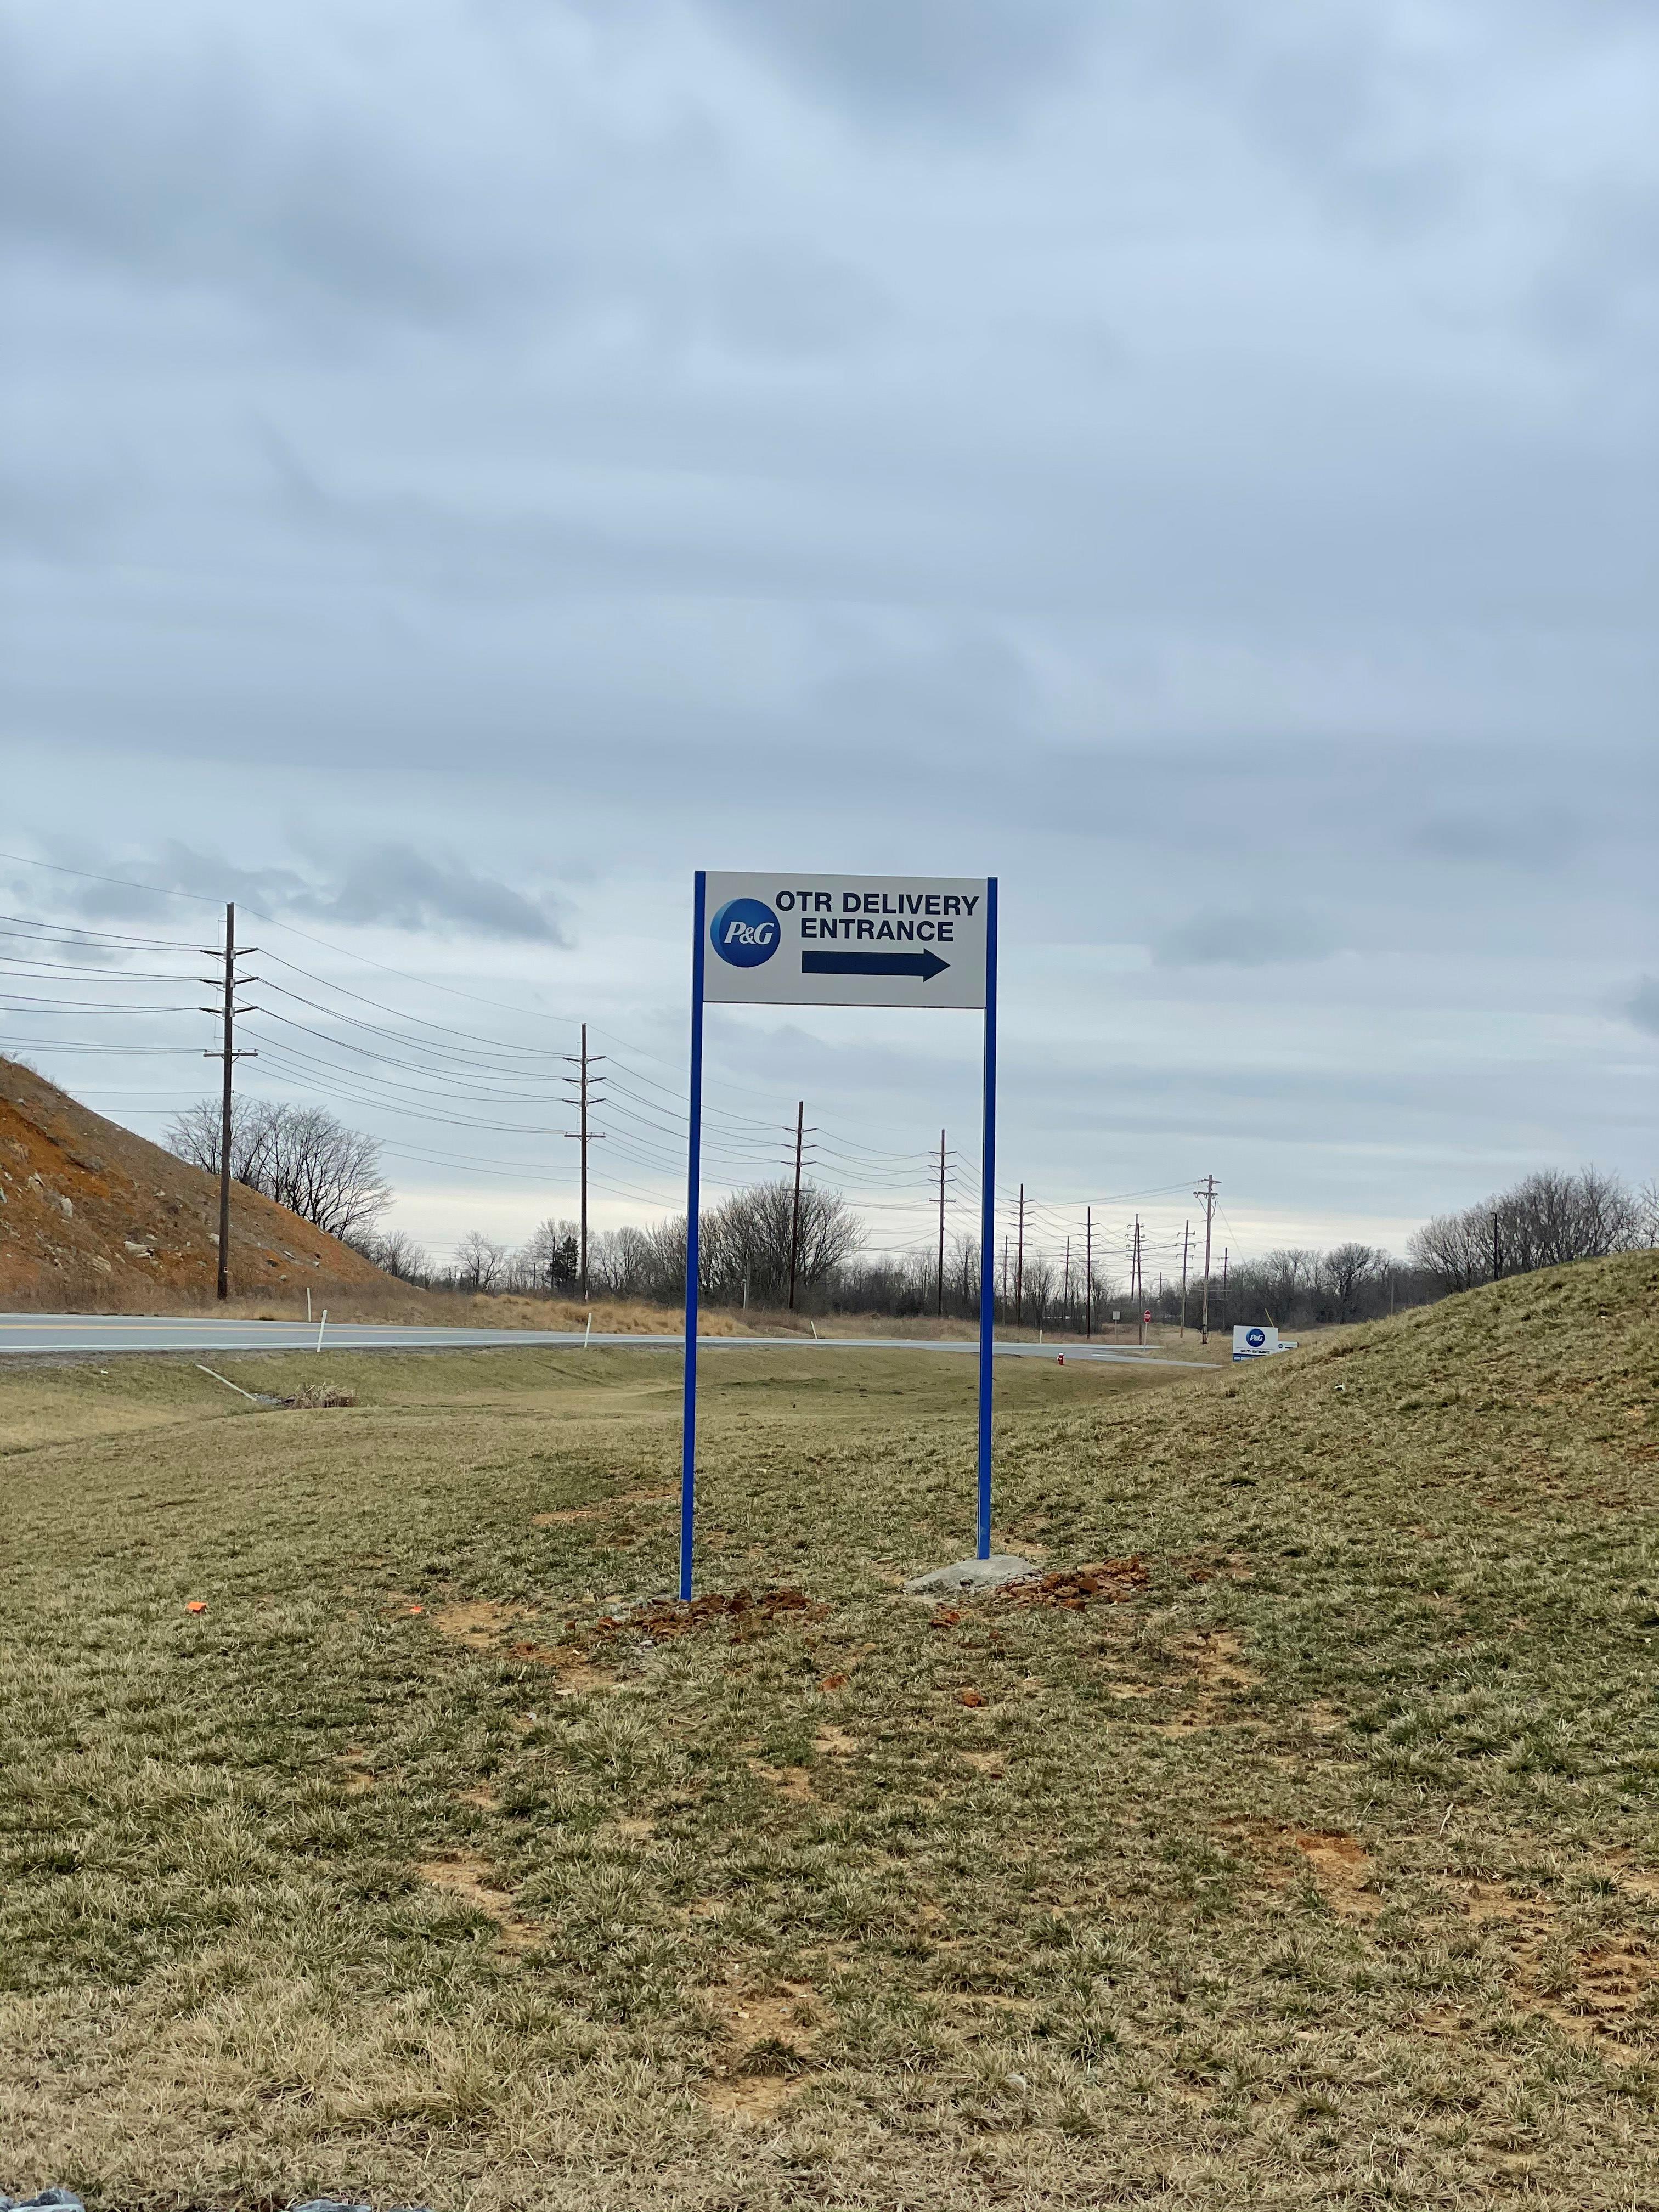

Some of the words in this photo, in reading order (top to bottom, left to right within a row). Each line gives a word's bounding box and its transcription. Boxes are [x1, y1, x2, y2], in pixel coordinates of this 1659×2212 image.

[776, 891, 832, 912] OTR
[843, 893, 979, 916] DELIVERY
[724, 921, 774, 945] P&G
[801, 918, 954, 941] ENTRANCE
